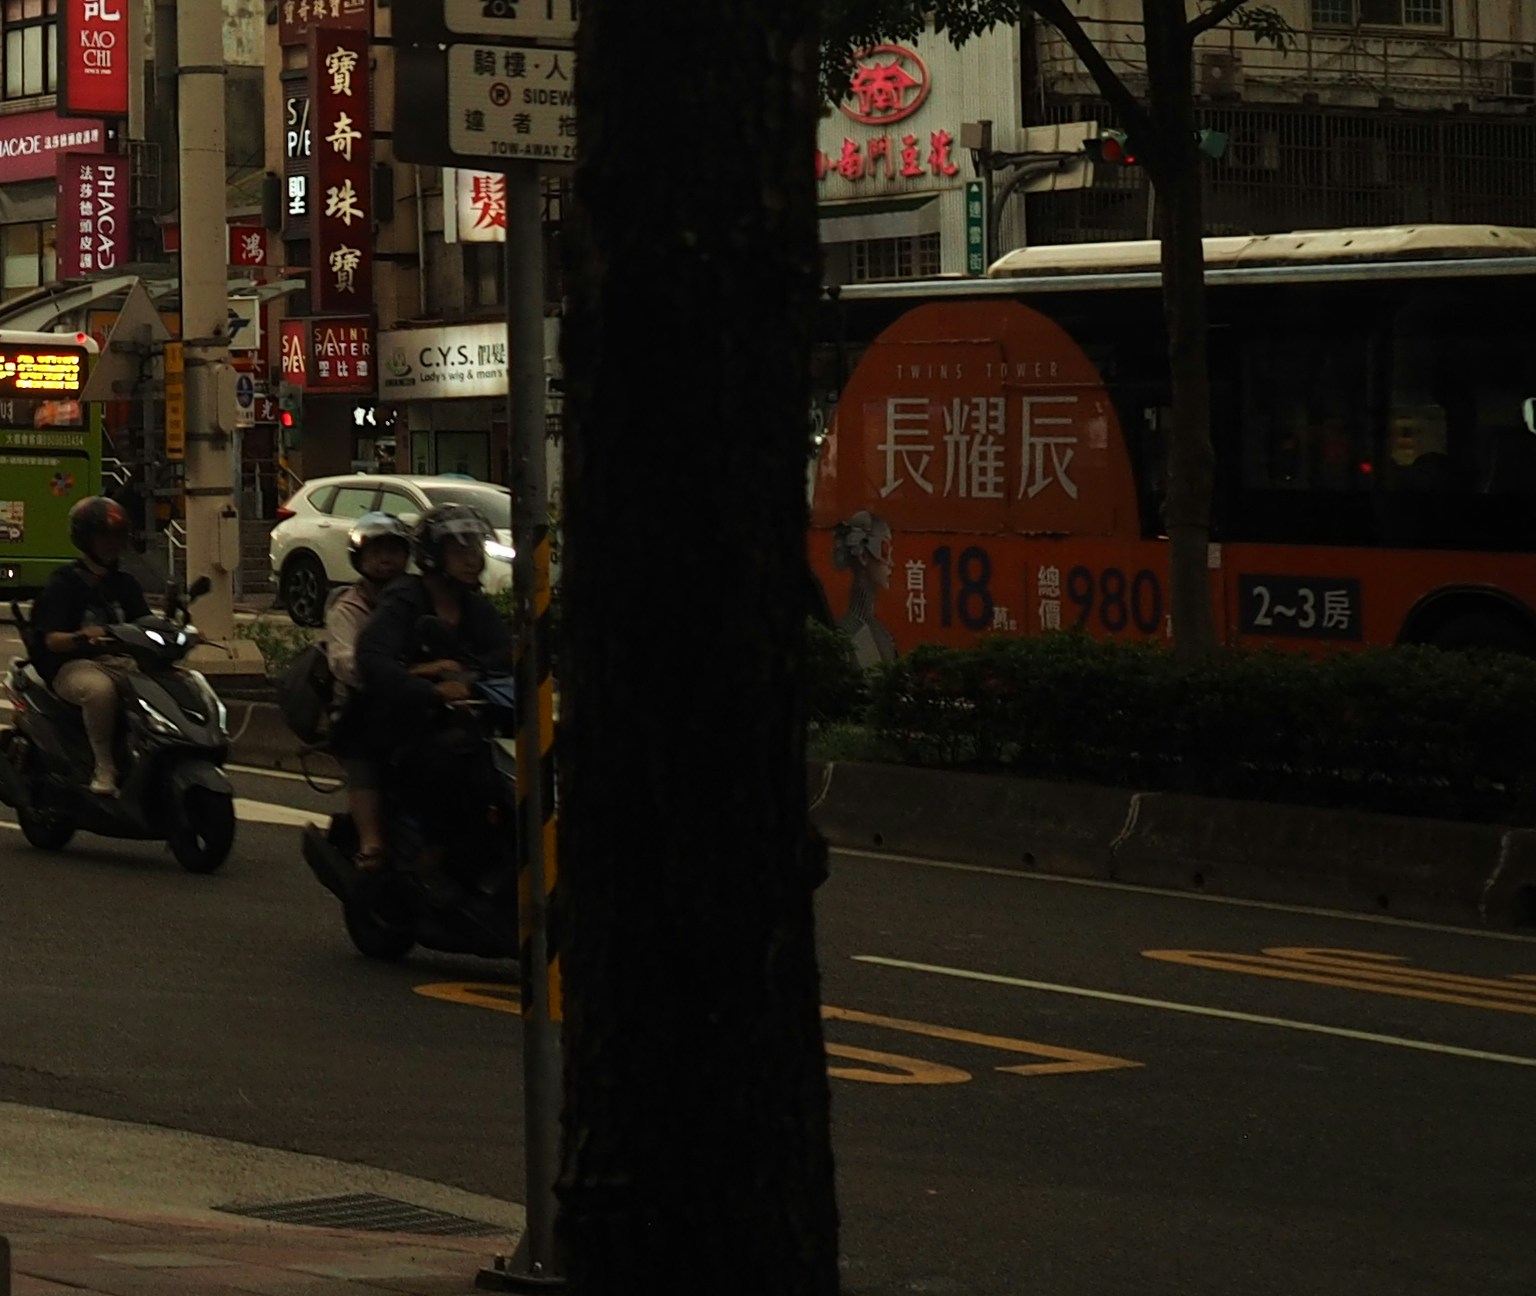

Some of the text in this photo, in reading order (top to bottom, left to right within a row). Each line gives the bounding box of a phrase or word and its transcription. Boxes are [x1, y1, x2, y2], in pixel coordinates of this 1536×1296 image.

[80, 30, 115, 48] KAO
[83, 49, 111, 67] CHI
[464, 109, 577, 138] 違者拖
[490, 141, 559, 159] TOW-AWAY
[323, 45, 365, 294] 寶奇珠寶
[79, 165, 93, 269] 法莎德頭皮護
[241, 233, 264, 263] 鴻
[314, 327, 369, 356] SAINT
[314, 342, 371, 357] PETER
[419, 345, 474, 368] C.Y.S.
[896, 362, 1060, 378] TWINS TOWER
[419, 368, 446, 384] Lady's
[448, 367, 464, 382] wig
[466, 368, 474, 380] &
[877, 396, 1078, 499] 長耀辰
[905, 561, 927, 623] 首付
[932, 545, 994, 630] 18
[1037, 565, 1061, 630] 總價
[1066, 565, 1162, 634] 980
